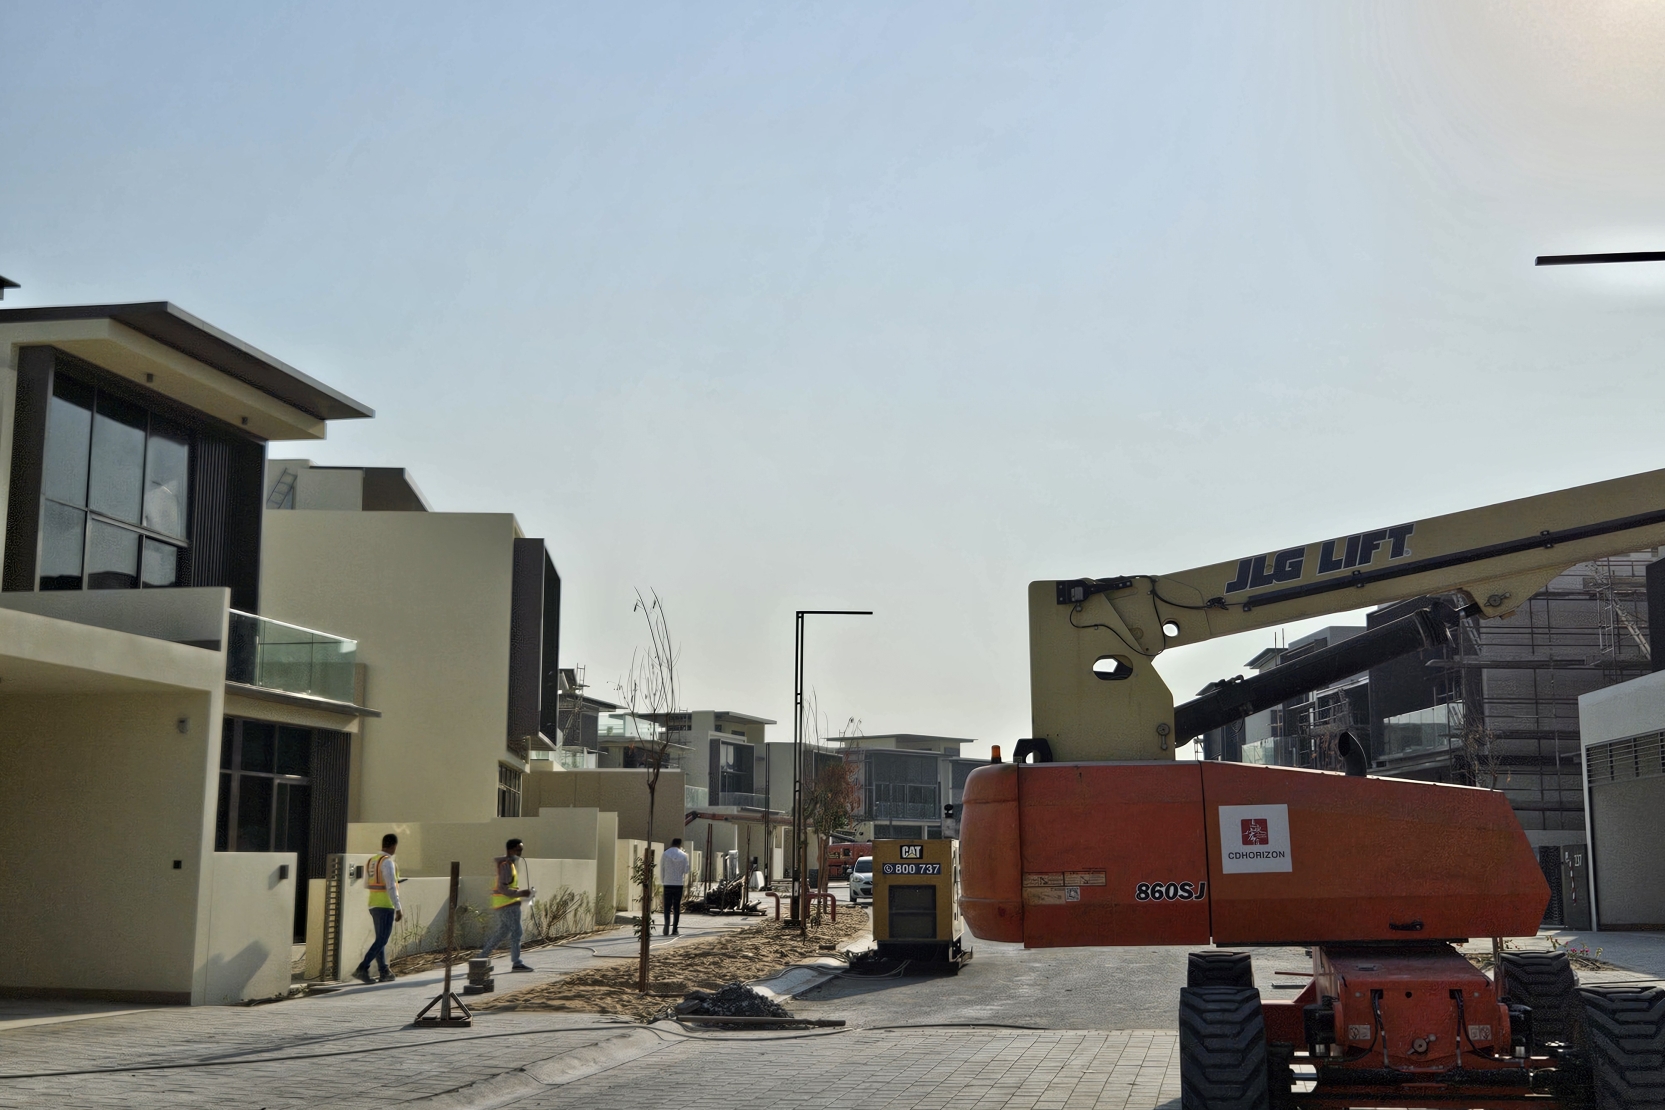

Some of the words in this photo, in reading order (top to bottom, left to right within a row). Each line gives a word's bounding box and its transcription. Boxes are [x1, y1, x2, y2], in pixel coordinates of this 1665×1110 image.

[1225, 546, 1306, 594] JLG
[1316, 523, 1415, 575] LIFT
[901, 845, 922, 858] CAT
[1228, 850, 1286, 860] CDHORIZON
[895, 864, 916, 874] 800
[919, 864, 940, 874] 737
[1135, 881, 1206, 902] 860SJ
